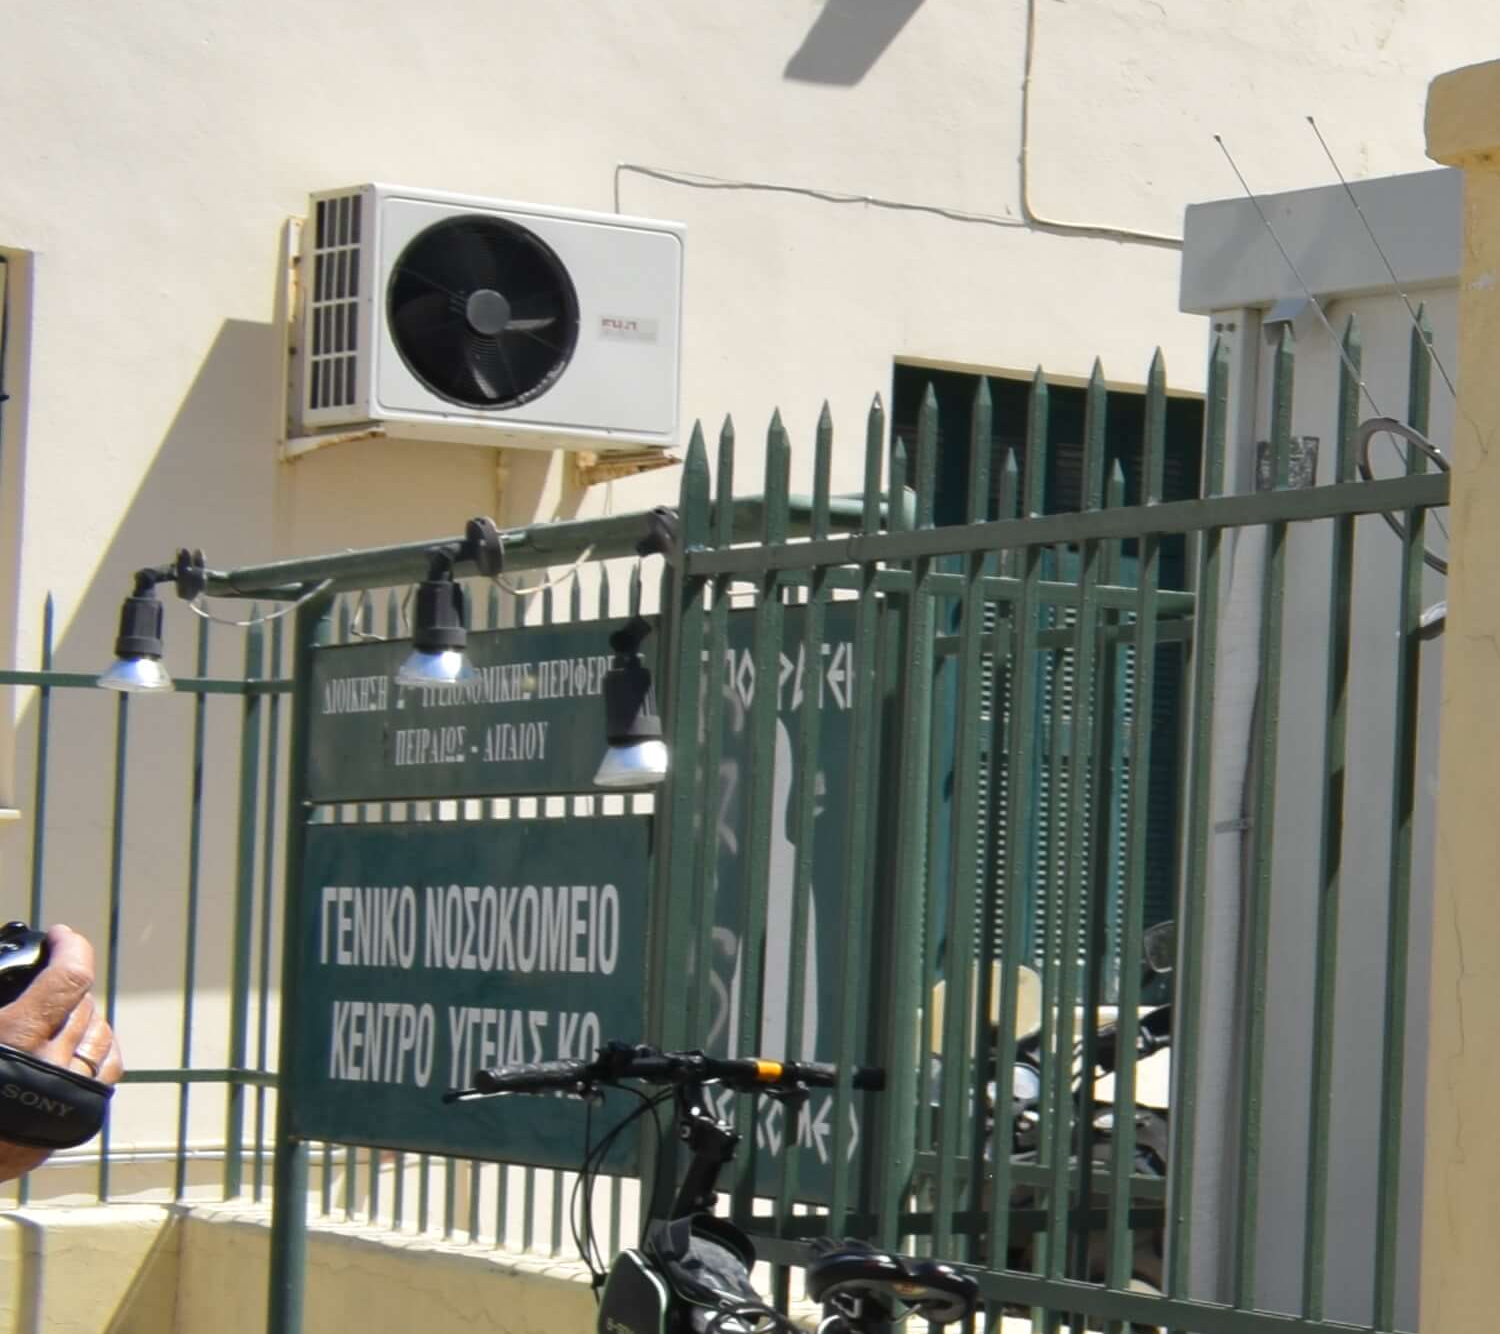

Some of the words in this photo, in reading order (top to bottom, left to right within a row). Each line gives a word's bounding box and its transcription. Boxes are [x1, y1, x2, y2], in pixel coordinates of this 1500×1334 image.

[538, 653, 645, 700] ΠΕΡΙΦΕΡ
[321, 885, 416, 969] ΓΕΝΙΚΟ
[425, 884, 620, 975] ΝΟΣΟΚΟΜΕΙΟ
[329, 1000, 435, 1088] ΚΕΝΤΡΟ
[2, 1083, 76, 1117] SONY
